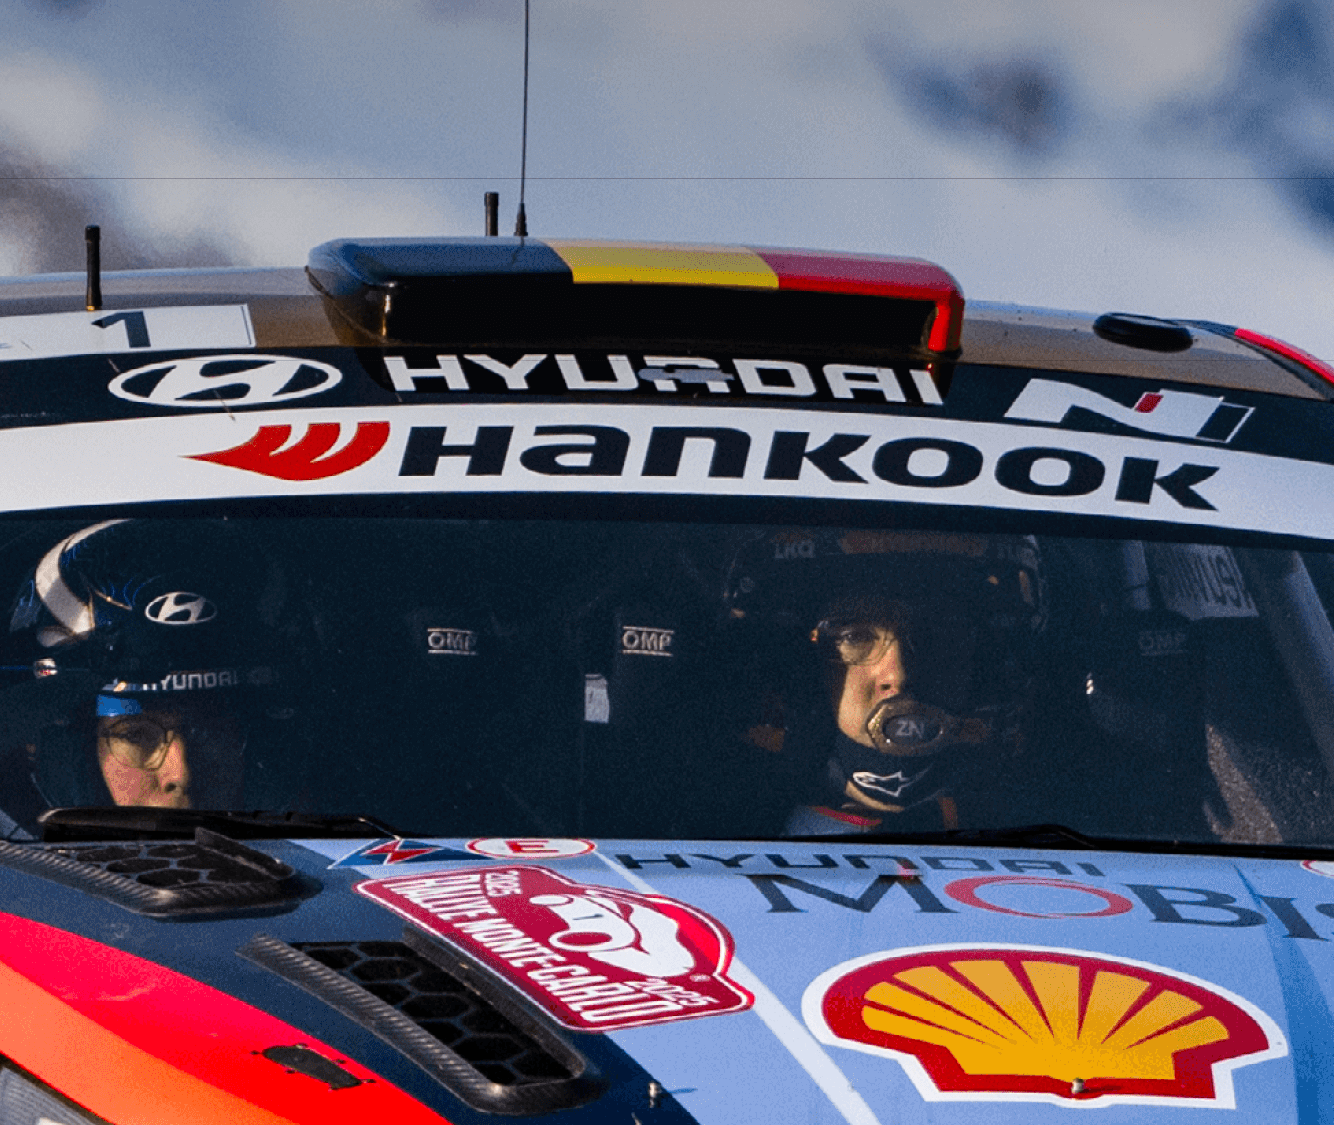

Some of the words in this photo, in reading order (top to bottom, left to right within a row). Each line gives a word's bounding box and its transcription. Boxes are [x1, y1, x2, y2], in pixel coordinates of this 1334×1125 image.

[93, 310, 152, 348] 1
[383, 353, 945, 406] HYUNDAI
[622, 629, 674, 652] OMP
[506, 840, 559, 854] E
[614, 853, 1106, 877] HYUNDAI
[382, 874, 498, 921] RALLYE
[453, 917, 683, 1023] MONTE-CARLO
